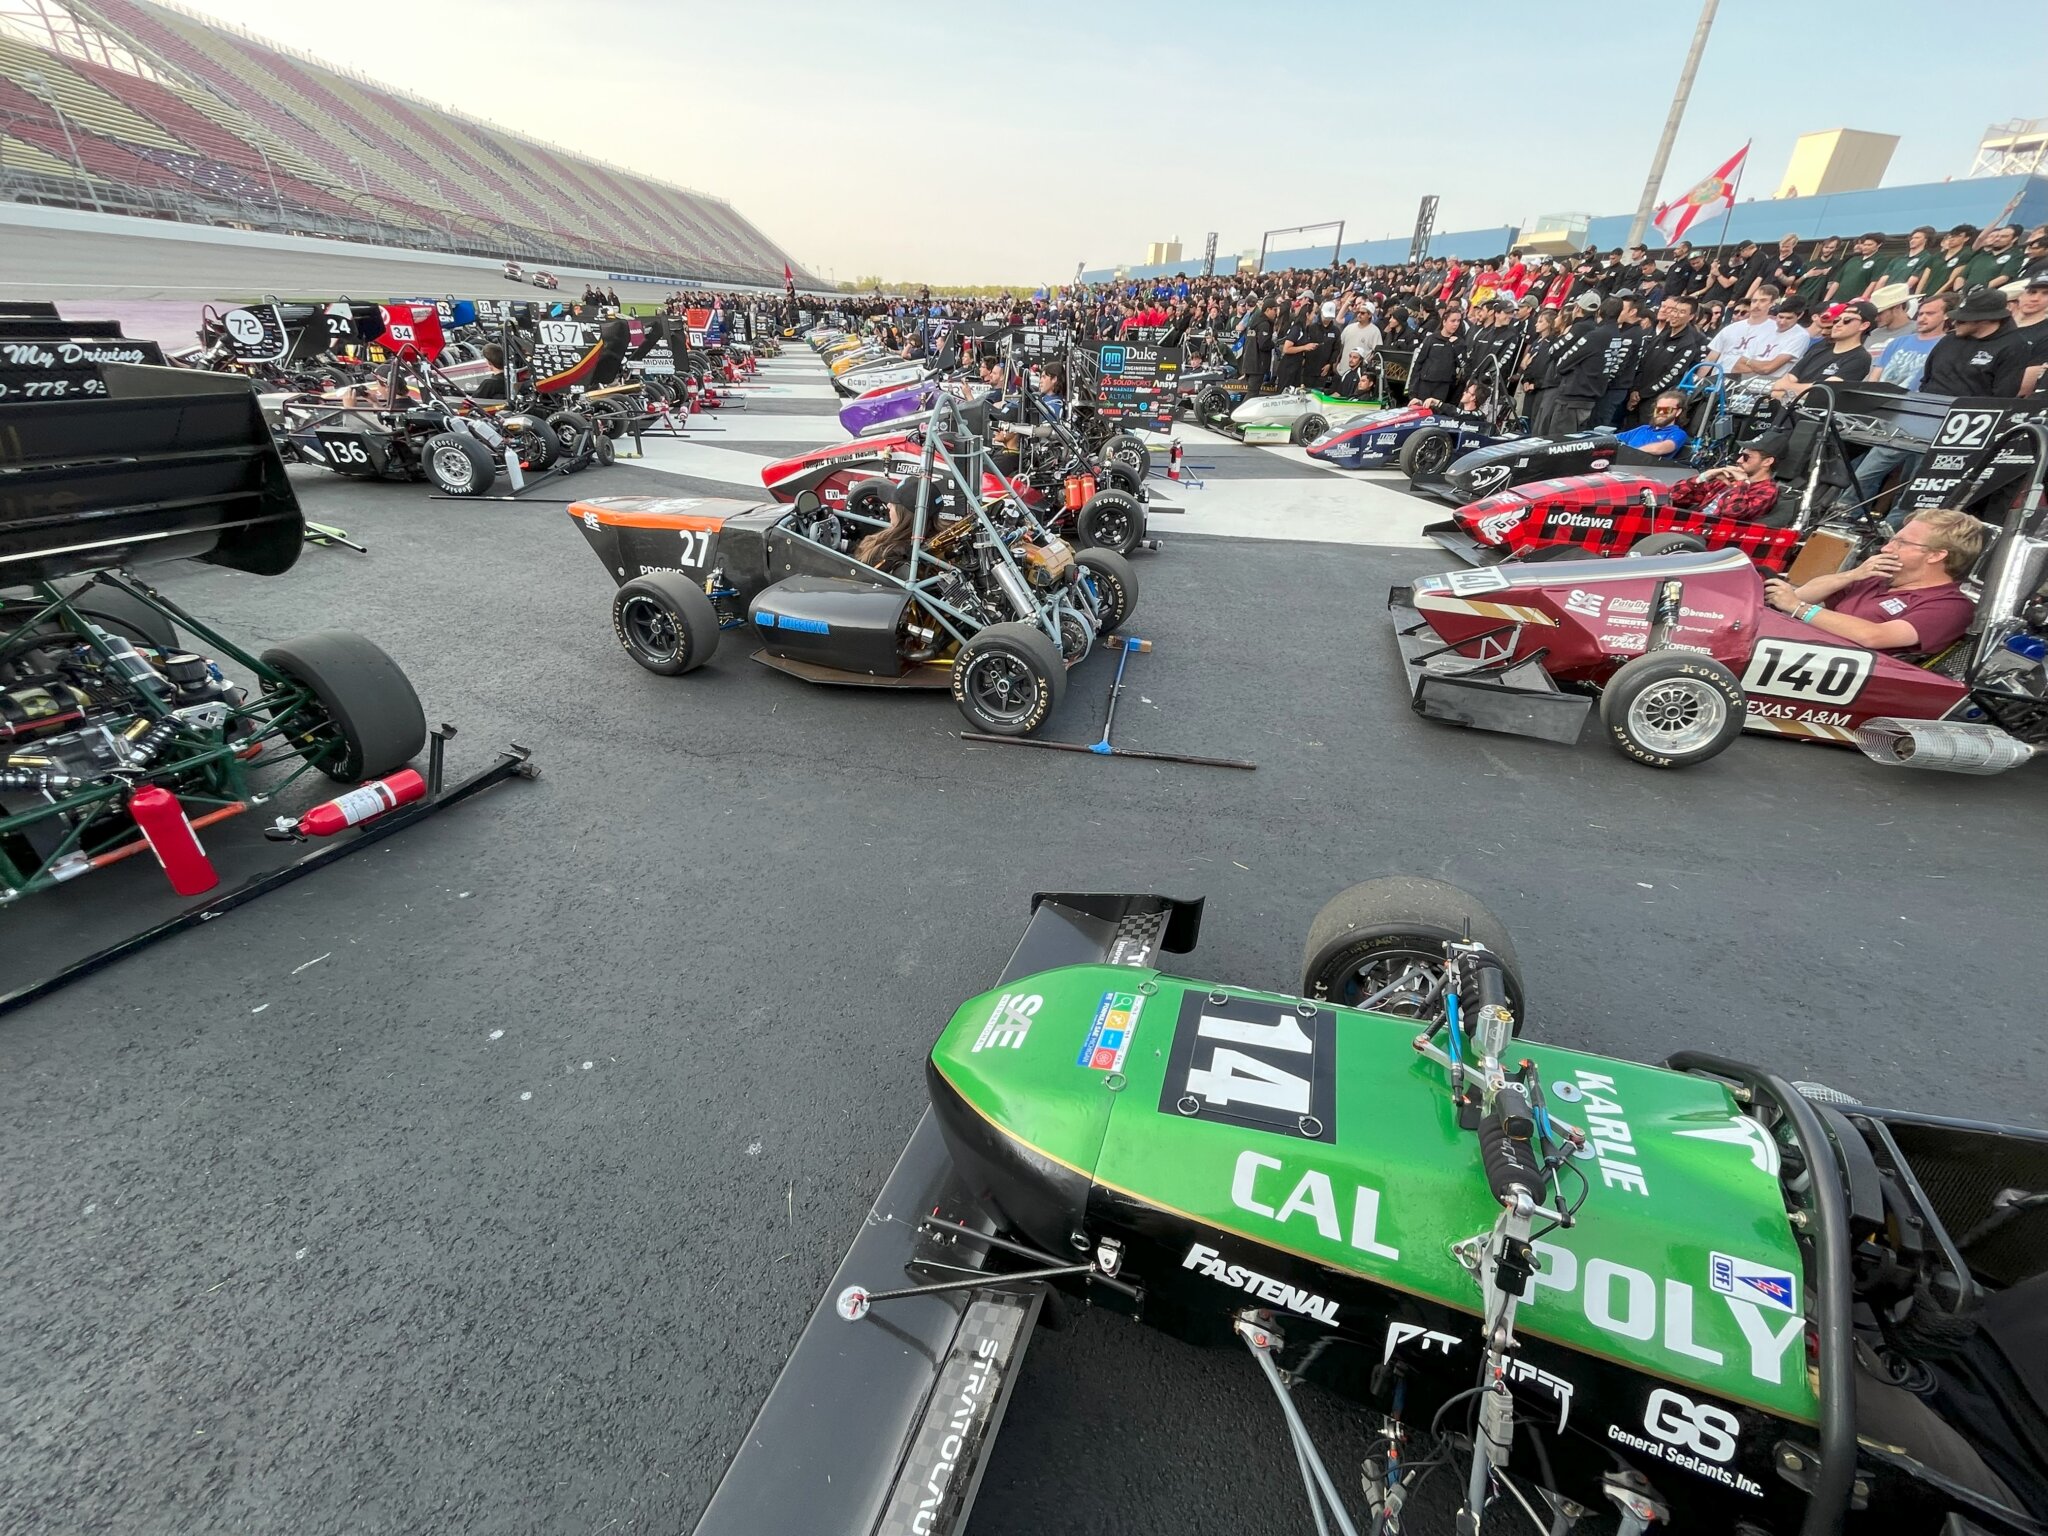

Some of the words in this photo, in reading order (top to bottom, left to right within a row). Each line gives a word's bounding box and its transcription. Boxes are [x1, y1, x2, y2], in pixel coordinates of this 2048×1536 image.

[230, 318, 260, 335] 72
[327, 318, 351, 334] 24
[394, 327, 413, 340] 34
[542, 323, 579, 344] 137
[692, 334, 702, 345] 19
[3, 344, 55, 369] My
[57, 343, 146, 364] Driving
[643, 358, 674, 367] MIDWAY
[1105, 351, 1122, 367] gm
[1126, 346, 1158, 360] Duke
[1153, 379, 1178, 389] Ansys
[1941, 413, 1993, 445] 92
[324, 440, 369, 465] 136
[1548, 440, 1596, 455] MANITOBA
[1909, 477, 1963, 492] SKF
[1096, 497, 1132, 510] Hoosier
[1547, 511, 1614, 530] uOttawa
[679, 529, 710, 568] 27
[1452, 566, 1503, 590] 140
[1107, 574, 1124, 621] Hoosier
[1569, 589, 1606, 614] SAE
[1610, 598, 1651, 610] PolyDy
[1689, 607, 1726, 620] brembo
[1609, 641, 1647, 651] SPORTS
[952, 648, 976, 704] Hoosier
[1755, 647, 1861, 697] 140
[1678, 664, 1742, 706] Hoosier
[1024, 676, 1049, 731] Hoosier
[1745, 699, 1798, 720] EXAS
[1797, 710, 1852, 728] A&M
[1613, 725, 1673, 766] Hoosier
[1096, 1001, 1111, 1026] FORMULA
[1185, 1014, 1313, 1115] 14
[1574, 1069, 1650, 1198] KARLIE
[1231, 1150, 1399, 1261] CAL
[1517, 1240, 1806, 1385] POLY
[1714, 1261, 1730, 1289] OFF
[1181, 1242, 1341, 1328] FASTENAL
[1383, 1321, 1463, 1366] PIT
[1643, 1388, 1741, 1463] GS
[1607, 1423, 1664, 1459] General
[1665, 1446, 1736, 1489] Sealants,
[1735, 1474, 1765, 1498] Inc.
